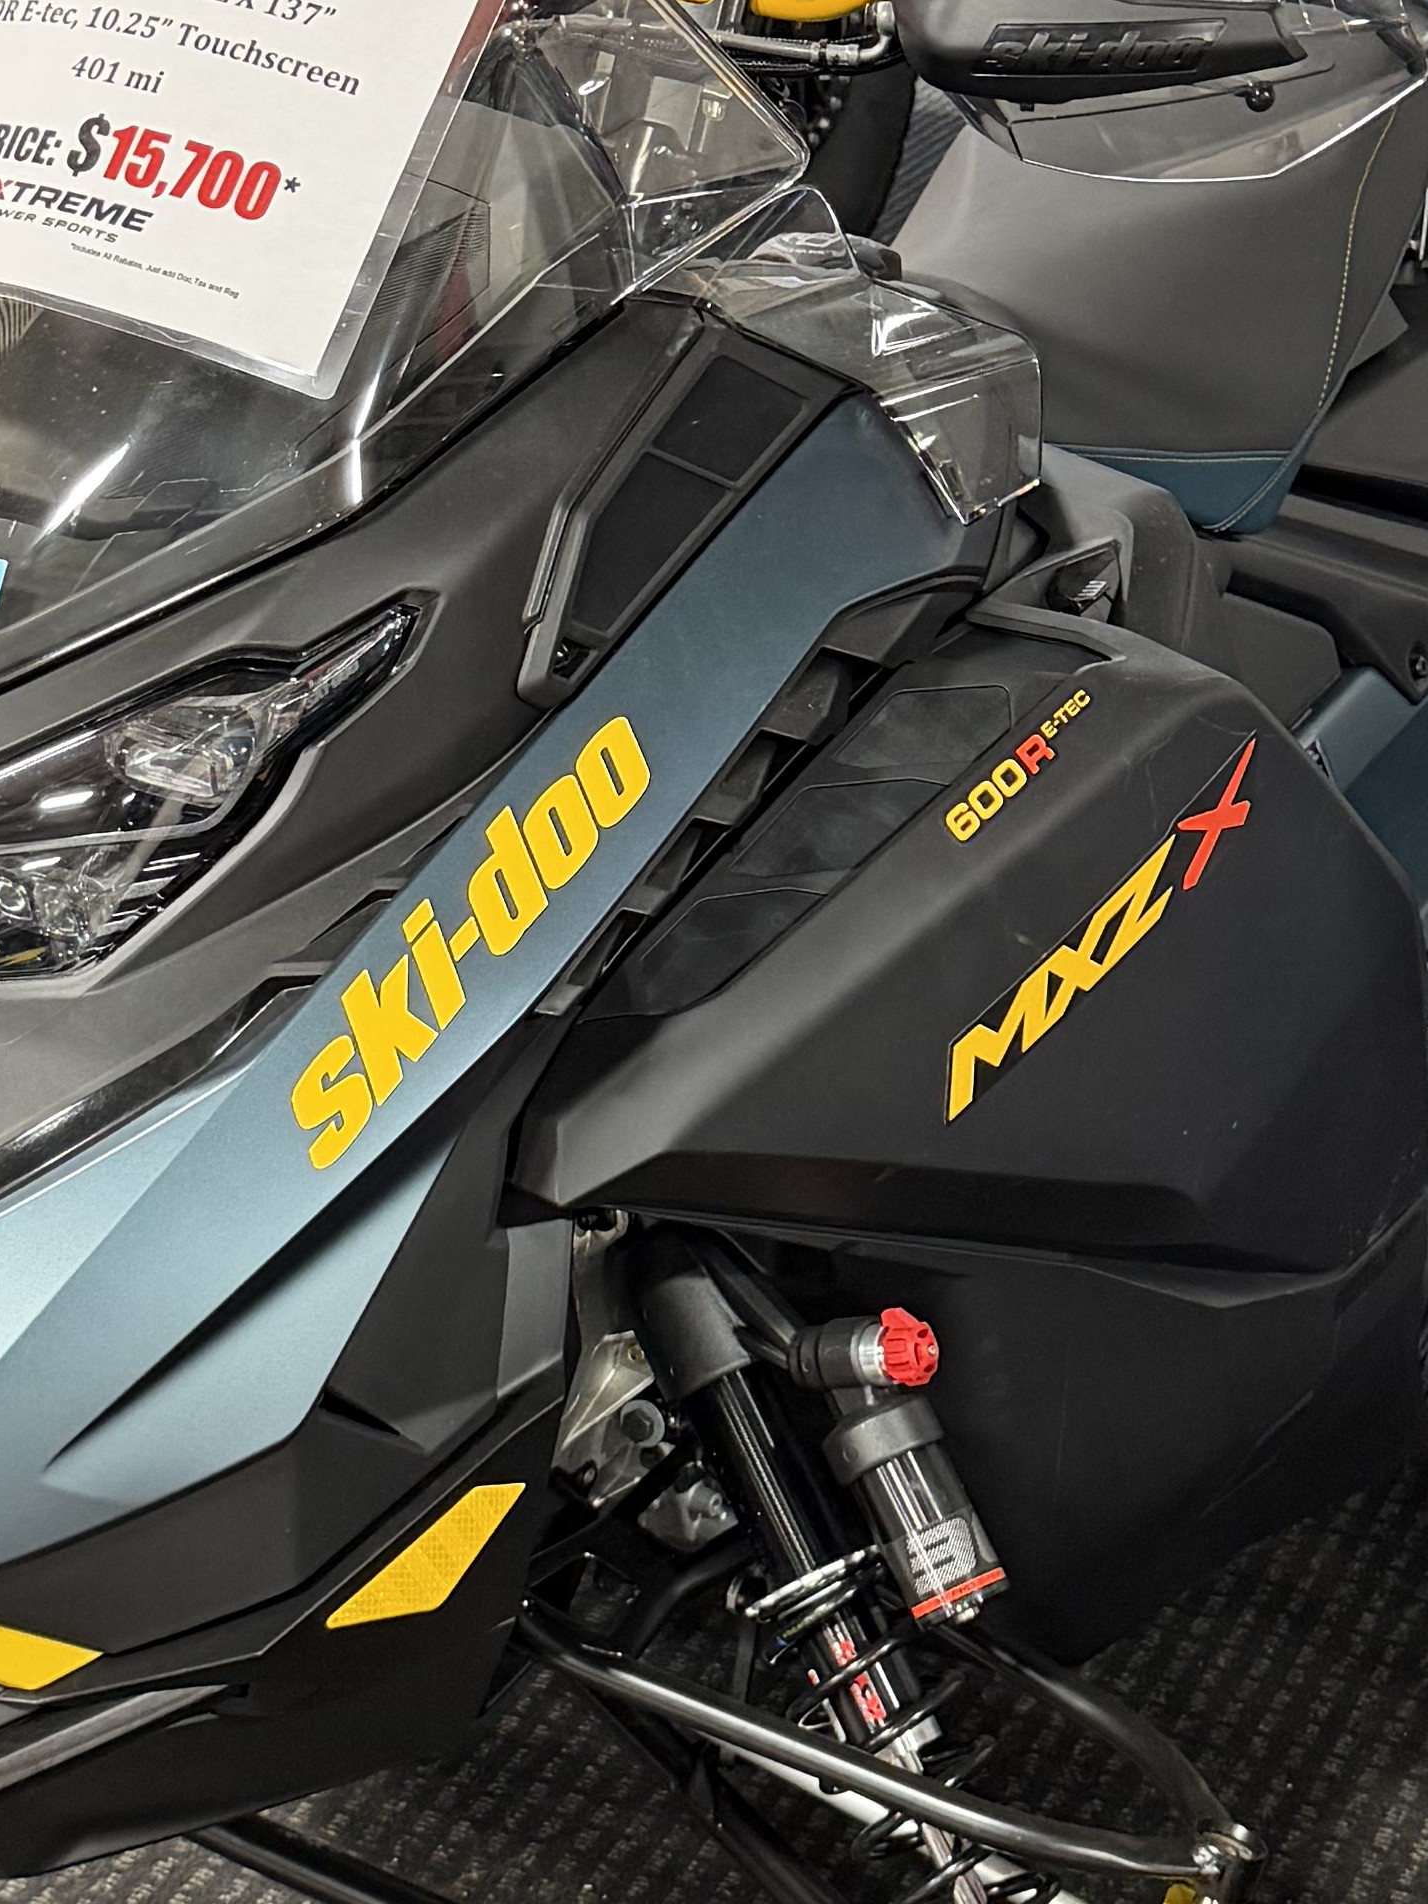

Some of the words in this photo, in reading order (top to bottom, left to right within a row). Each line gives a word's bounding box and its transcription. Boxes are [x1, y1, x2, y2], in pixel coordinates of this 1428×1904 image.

[20, 1, 80, 30] E-tec,
[176, 23, 361, 95] Touchscreen
[71, 55, 119, 85] 401
[124, 70, 166, 94] mi
[42, 216, 118, 244] SPORTS
[945, 734, 1055, 842] 600R
[1040, 690, 1091, 740] E-TEC
[292, 716, 651, 1170] ski-doo
[948, 833, 1176, 1122] MXZ
[1177, 738, 1257, 891] X
